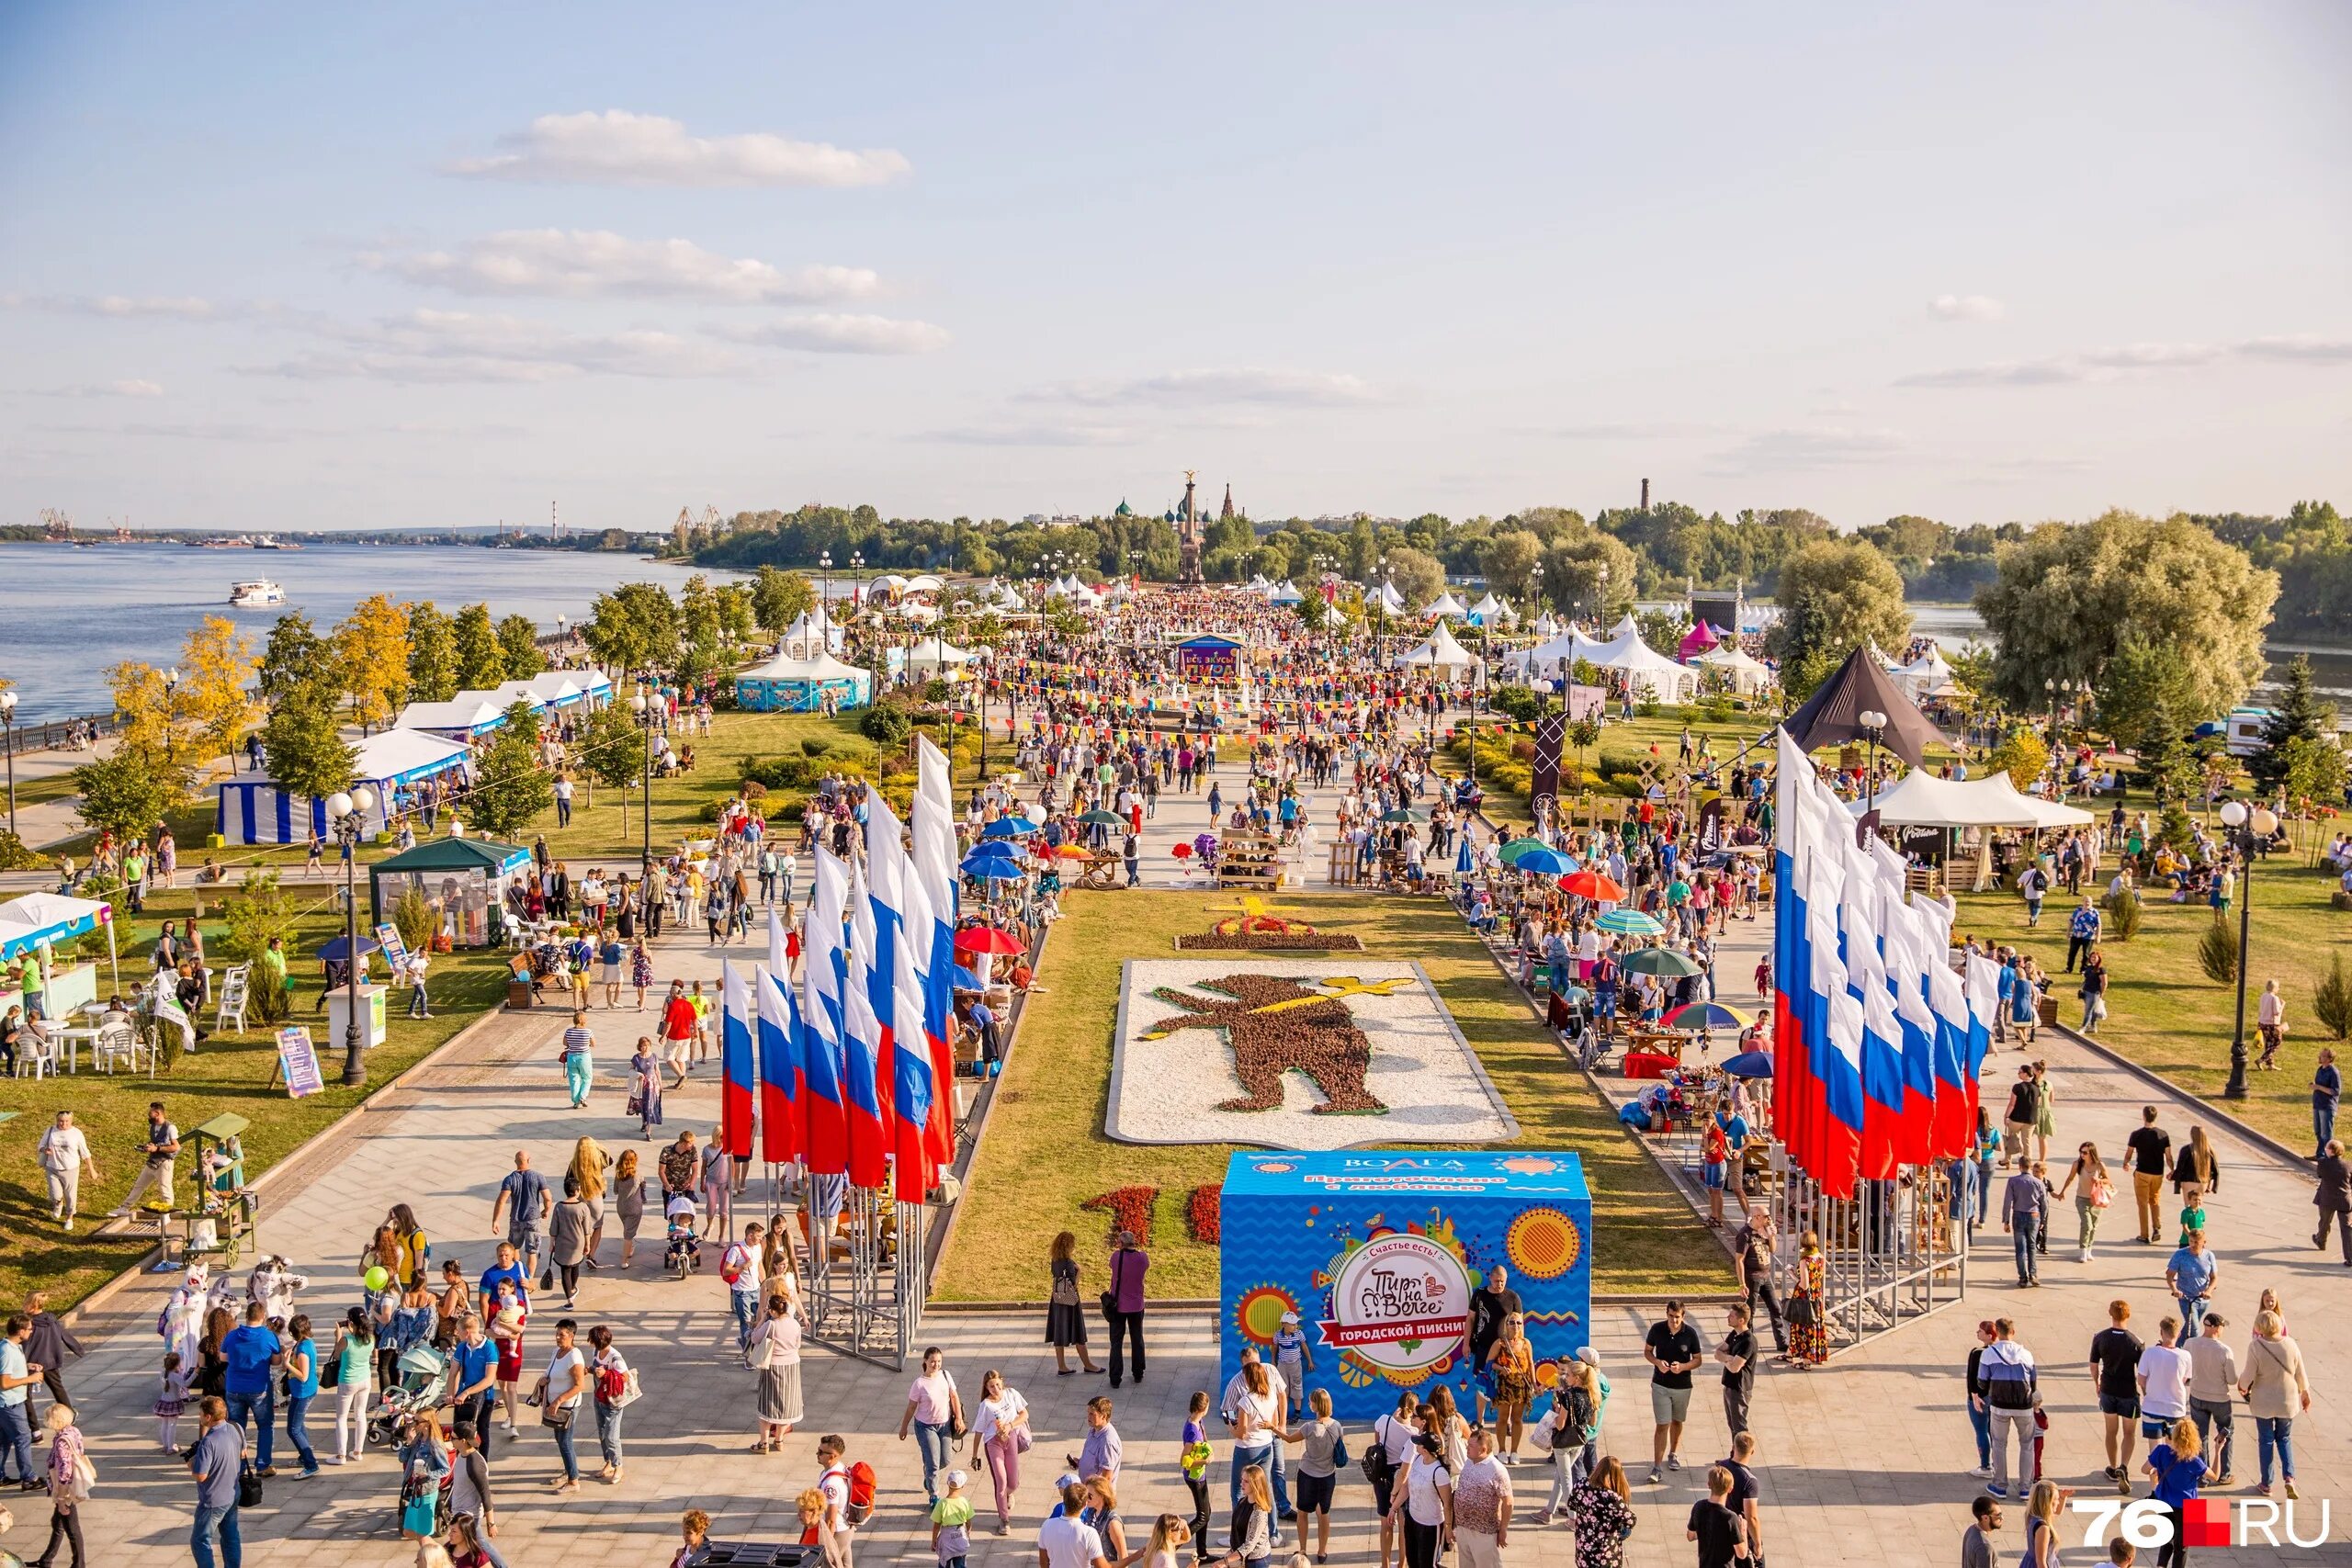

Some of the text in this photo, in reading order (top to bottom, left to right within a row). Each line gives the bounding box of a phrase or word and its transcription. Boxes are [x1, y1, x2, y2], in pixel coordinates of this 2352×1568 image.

[1345, 1158, 1464, 1171] ВОЛГА
[1303, 1175, 1509, 1184] Приготовлено
[1347, 1182, 1487, 1192] любовью
[1369, 1241, 1439, 1258] Счастье есть!
[1371, 1268, 1422, 1303] Пир
[1404, 1289, 1423, 1303] на
[1340, 1324, 1414, 1342] ГОРОДСКОЙ
